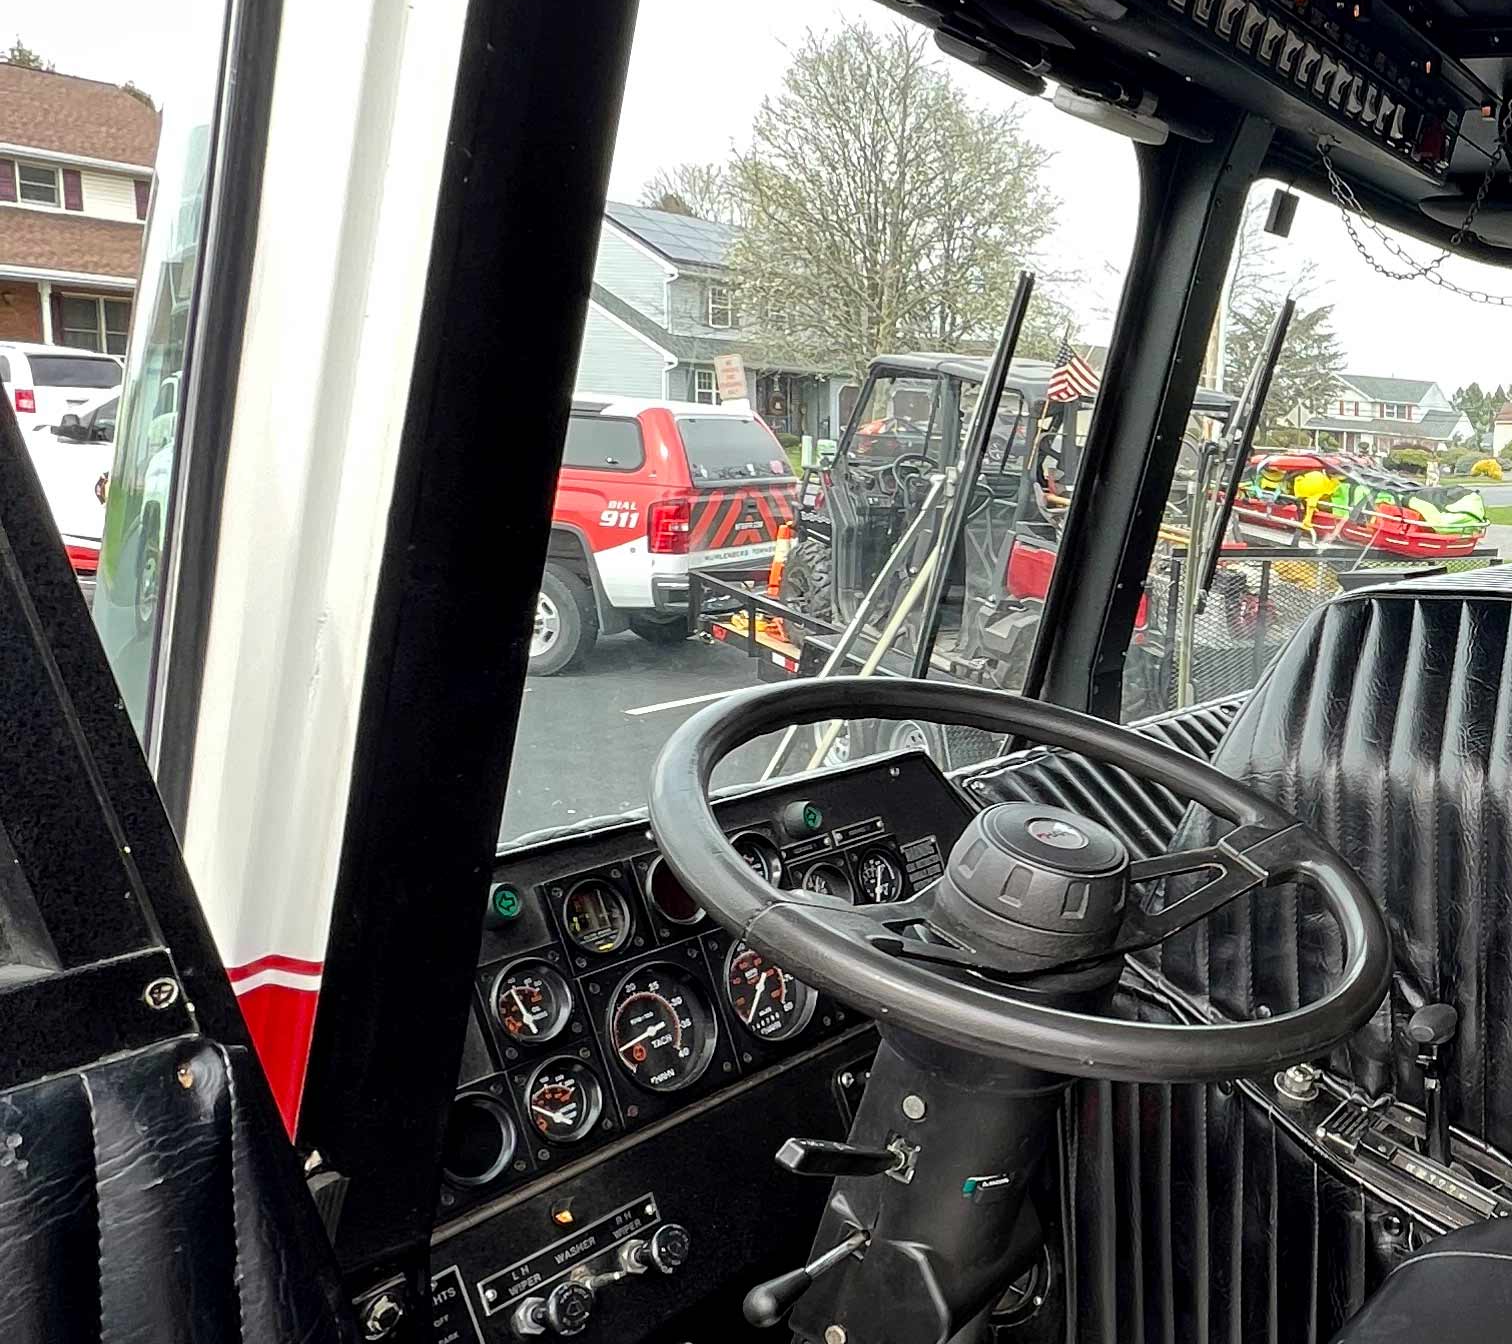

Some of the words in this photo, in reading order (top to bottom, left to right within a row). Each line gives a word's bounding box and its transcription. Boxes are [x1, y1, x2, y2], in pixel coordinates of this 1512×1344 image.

[607, 500, 637, 510] DIAL
[599, 511, 640, 529] 911
[651, 1034, 673, 1049] TACH
[612, 1218, 643, 1240] WIPER
[553, 1235, 597, 1265] WASHER
[508, 1273, 543, 1297] WIPER
